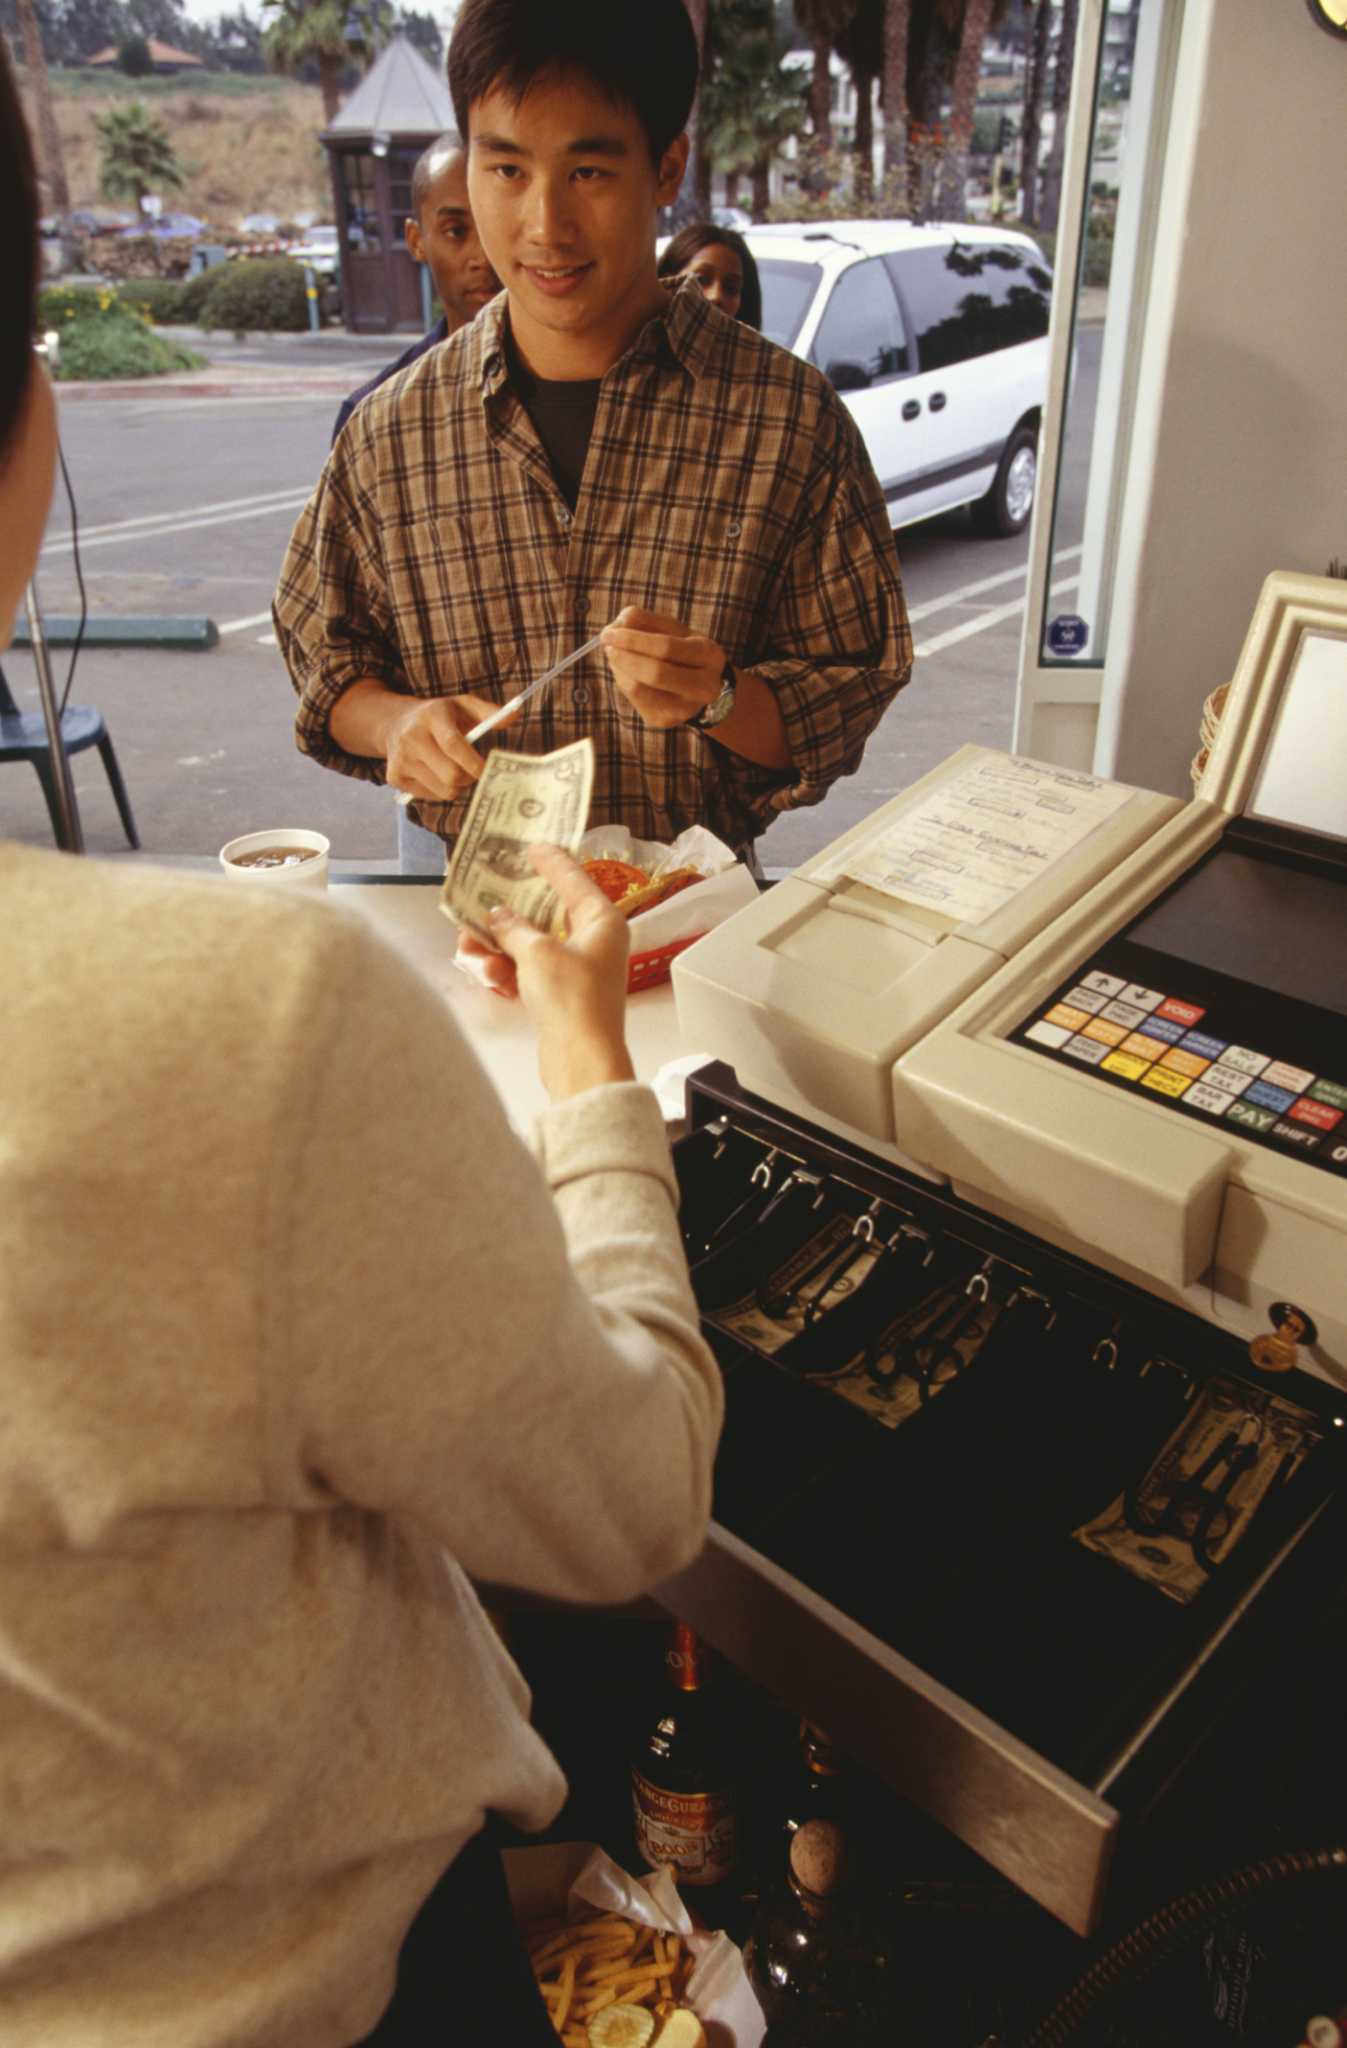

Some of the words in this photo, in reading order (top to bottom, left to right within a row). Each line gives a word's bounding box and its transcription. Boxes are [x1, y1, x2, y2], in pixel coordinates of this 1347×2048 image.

[1164, 1001, 1195, 1019] VOID
[1239, 1048, 1257, 1060] NO
[1223, 1055, 1258, 1072] SALE
[1211, 1075, 1233, 1089] TAX
[1212, 1067, 1245, 1082] REST
[1192, 1093, 1214, 1107] TAX
[1197, 1087, 1223, 1101] BAR
[1229, 1103, 1277, 1128] PAY
[1298, 1101, 1335, 1120] CLEAR
[1274, 1122, 1319, 1146] SHIFT
